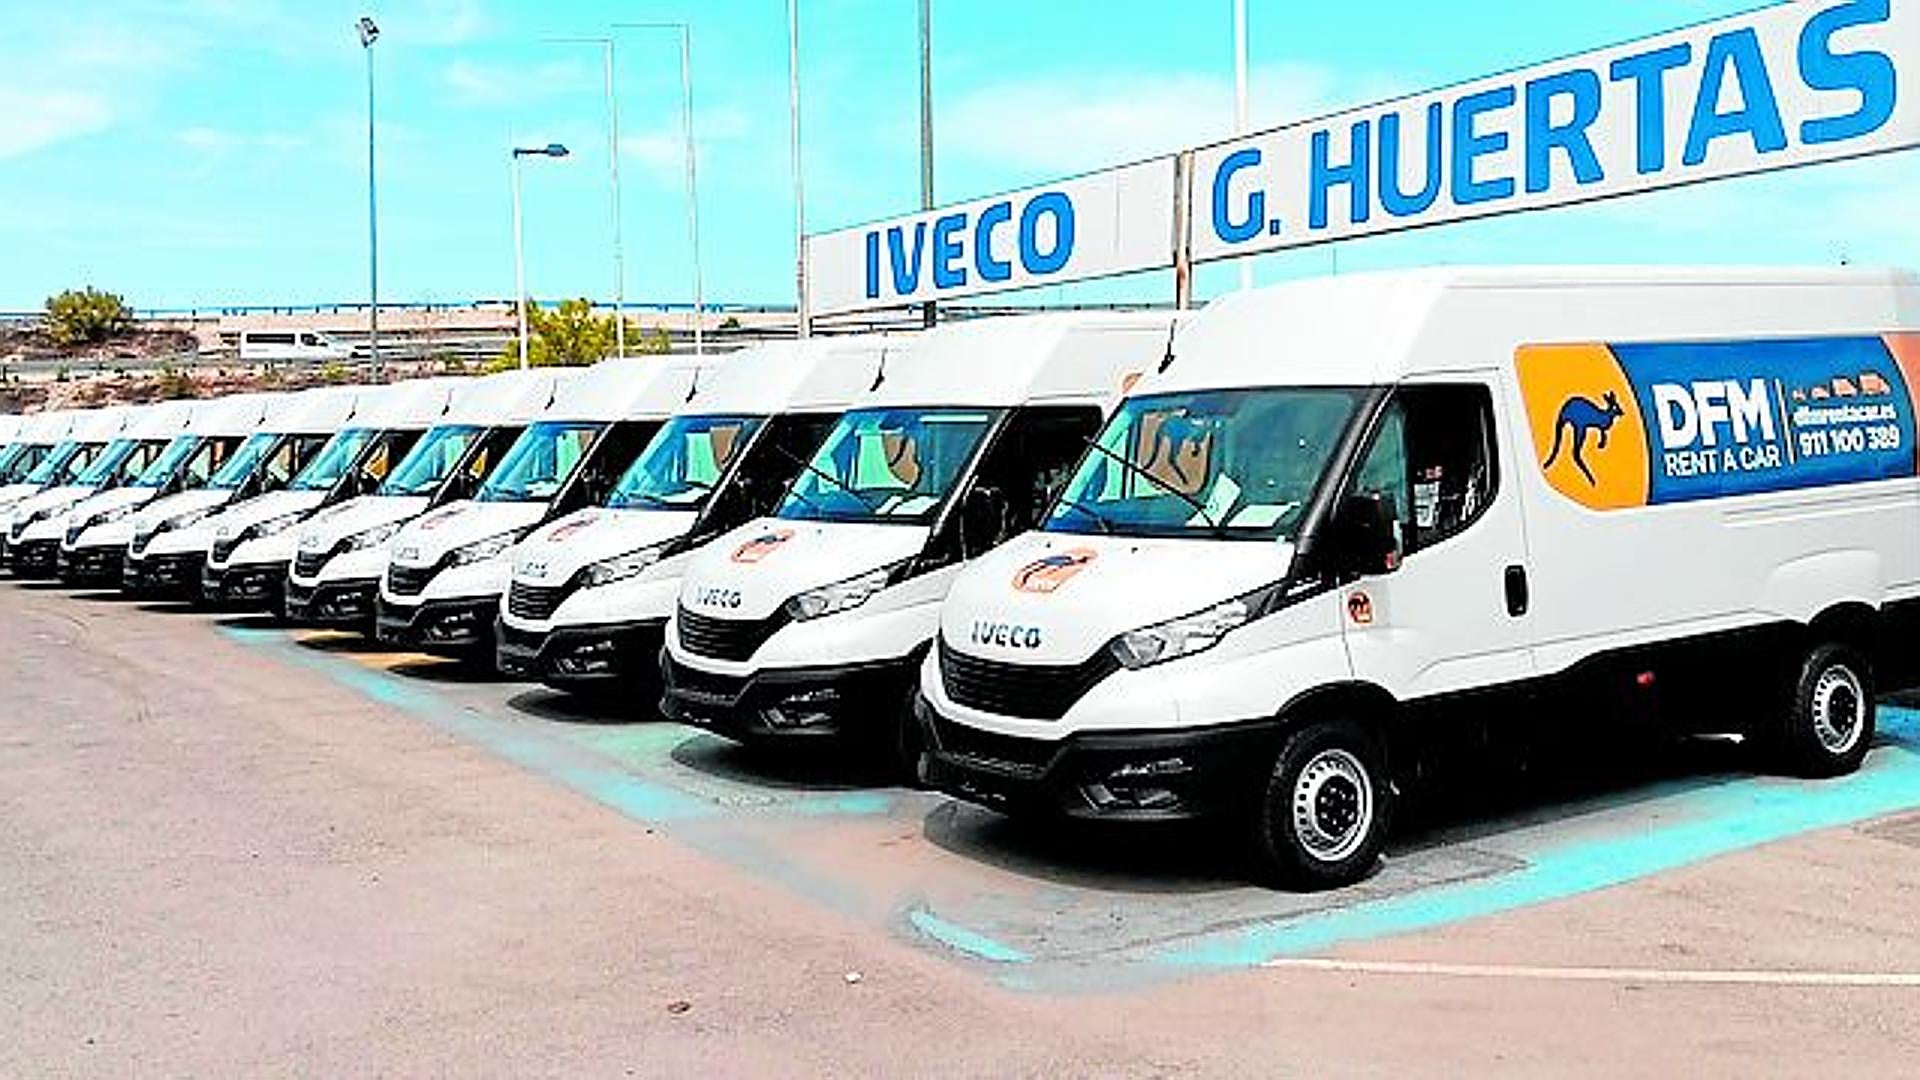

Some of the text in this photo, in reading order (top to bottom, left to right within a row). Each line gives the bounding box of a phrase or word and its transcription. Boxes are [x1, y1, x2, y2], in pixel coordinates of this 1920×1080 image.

[1212, 0, 1897, 244] G. HUERTAS
[866, 191, 1075, 298] IVECO
[1652, 378, 1776, 449] DFM
[1664, 444, 1780, 476] RENT A CAR
[1800, 424, 1900, 456] 911 100 389
[971, 620, 1041, 648] IVECO
